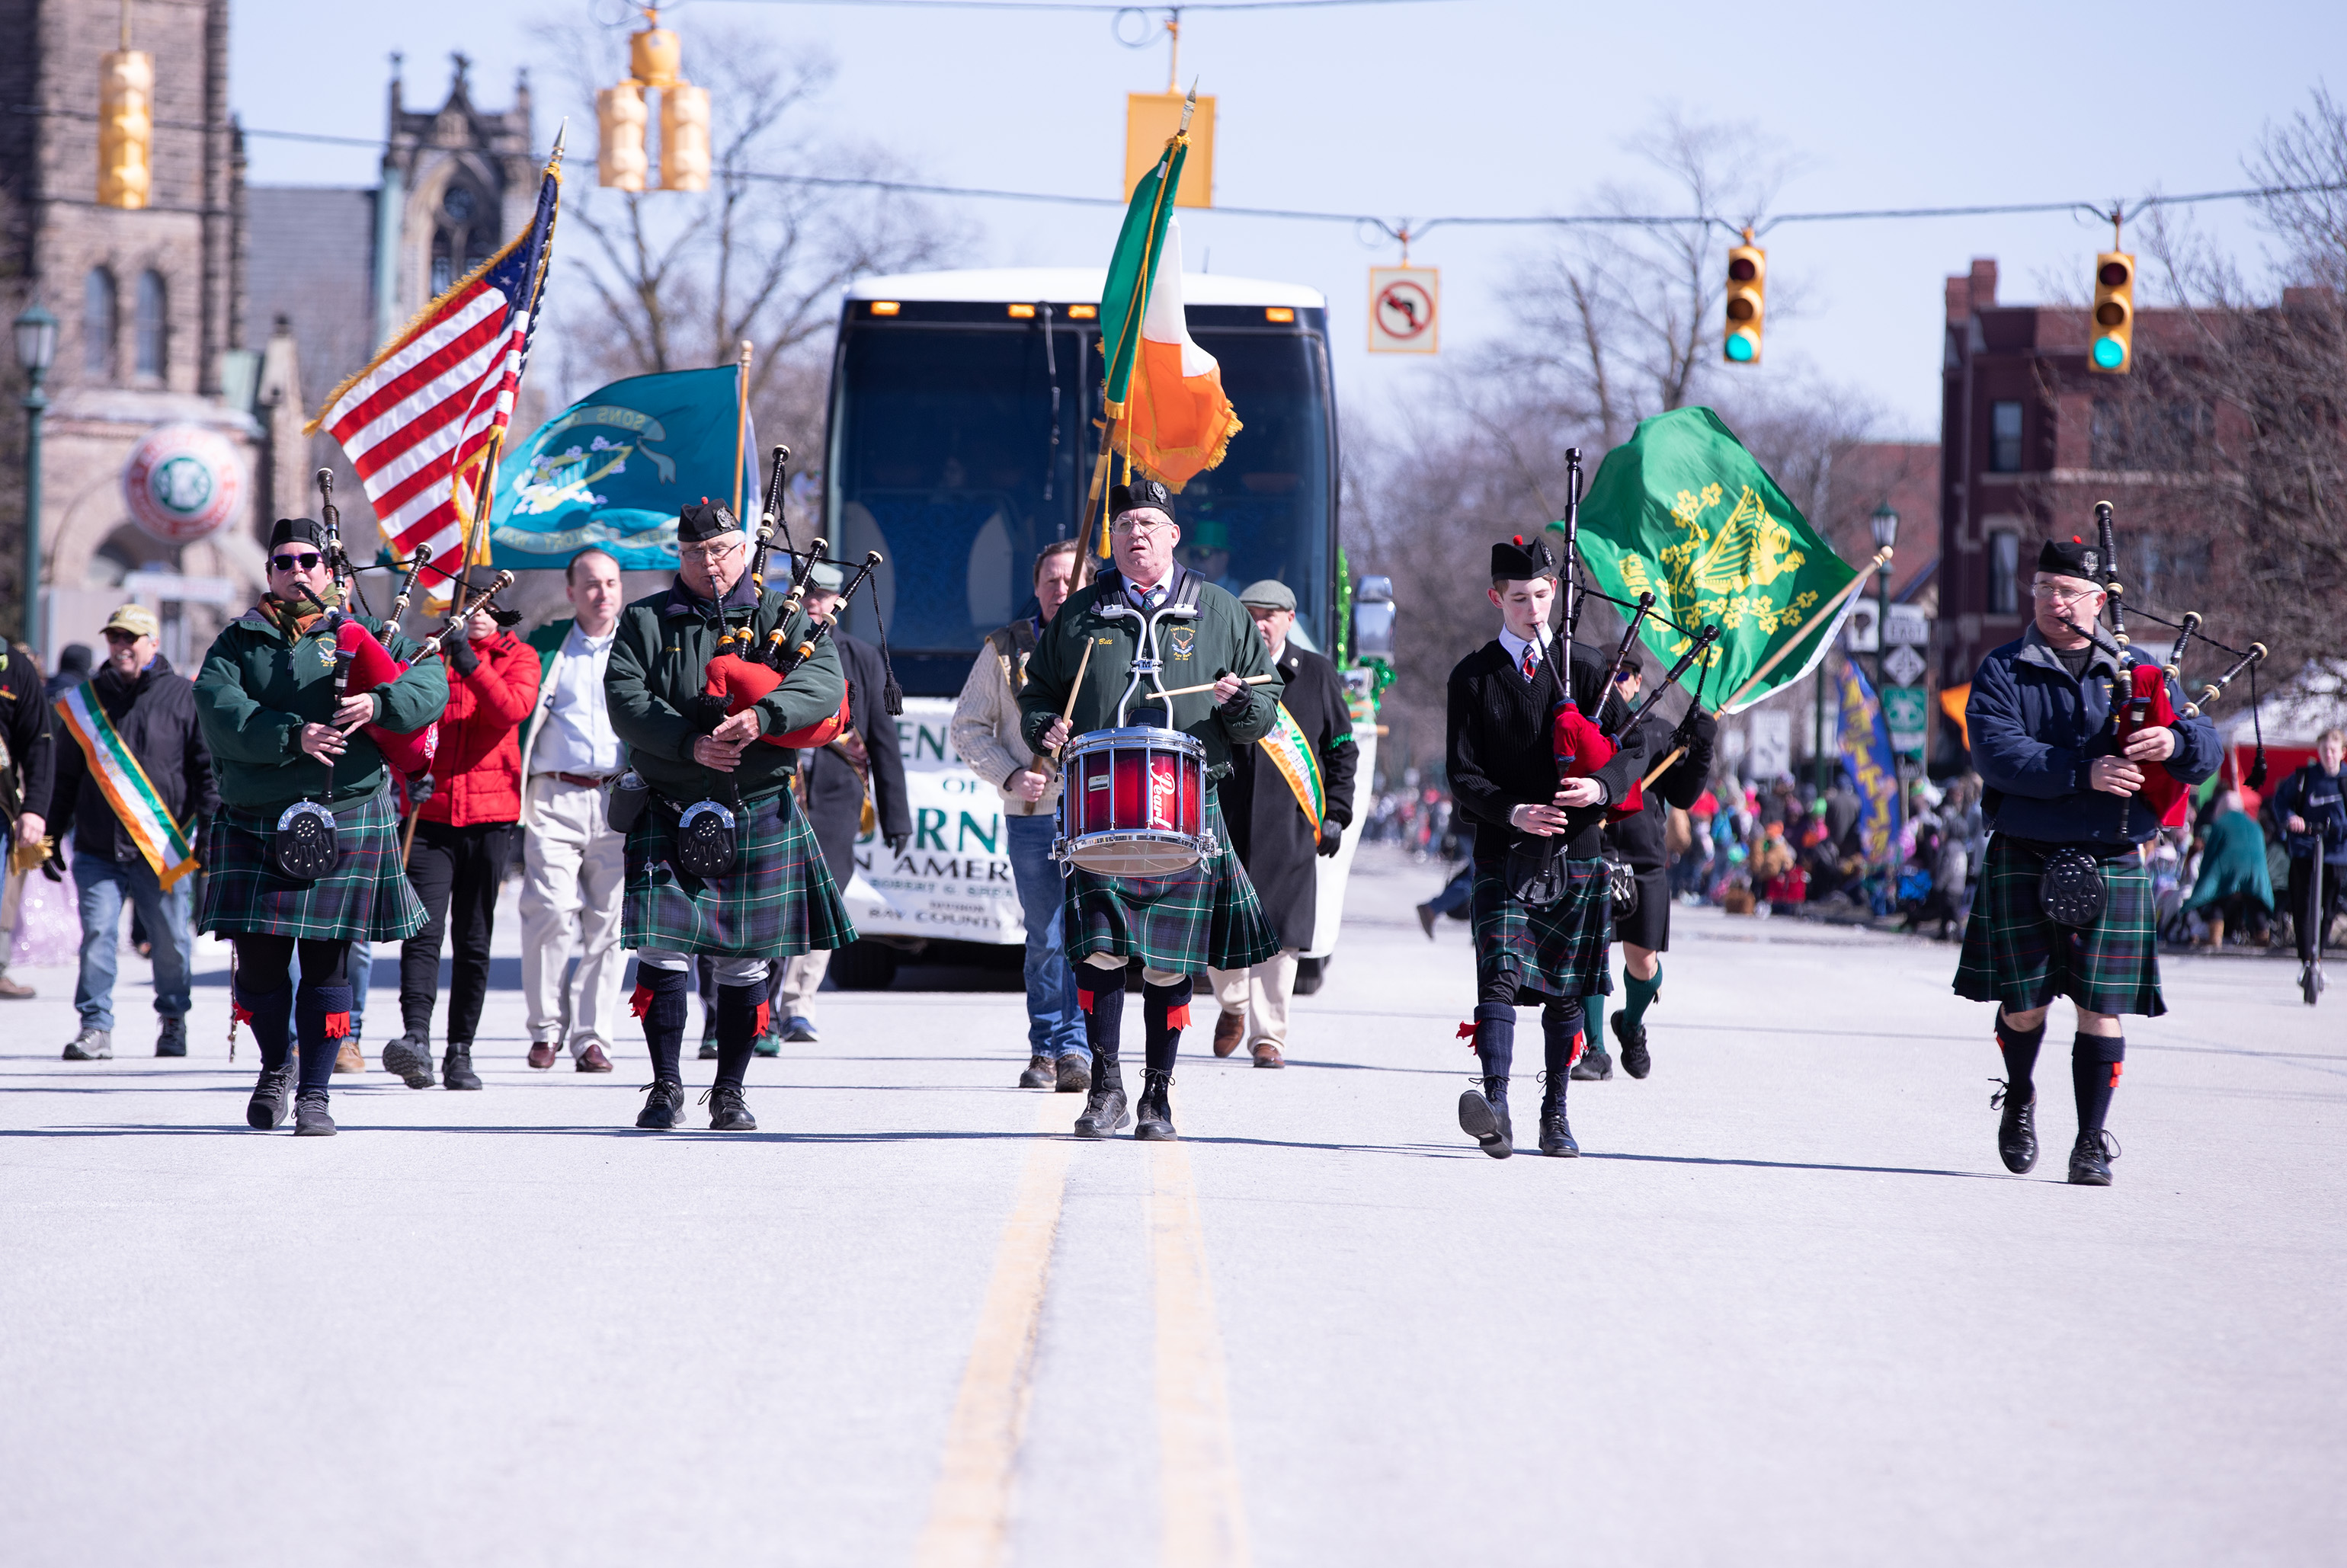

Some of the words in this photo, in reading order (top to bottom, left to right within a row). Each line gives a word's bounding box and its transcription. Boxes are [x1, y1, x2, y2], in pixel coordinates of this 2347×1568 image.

[943, 777, 981, 794] OF
[1150, 762, 1176, 830] Pearl
[894, 856, 1010, 882] AMER
